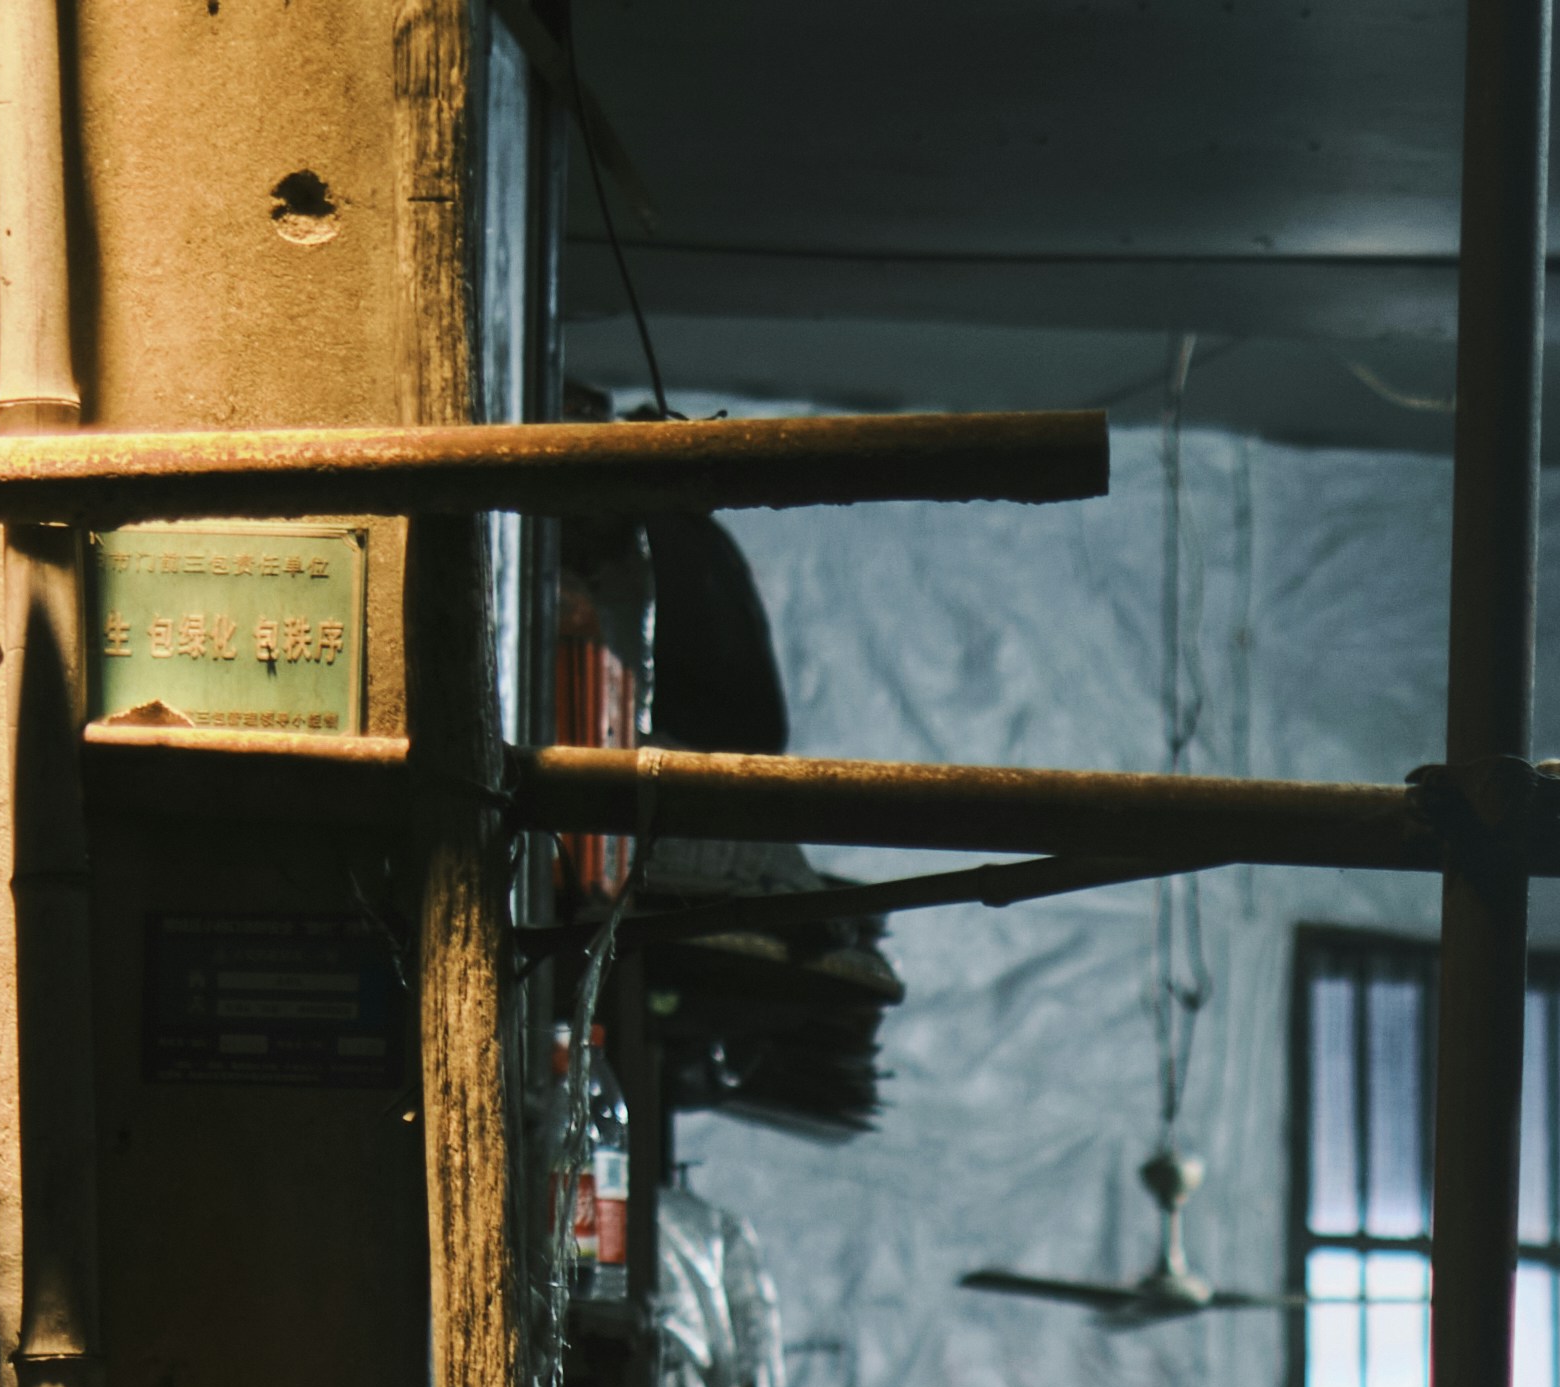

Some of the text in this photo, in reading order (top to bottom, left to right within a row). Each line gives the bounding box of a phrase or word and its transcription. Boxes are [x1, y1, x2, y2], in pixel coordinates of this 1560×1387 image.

[148, 612, 237, 660] 包绿化
[253, 614, 344, 666] 包秩序
